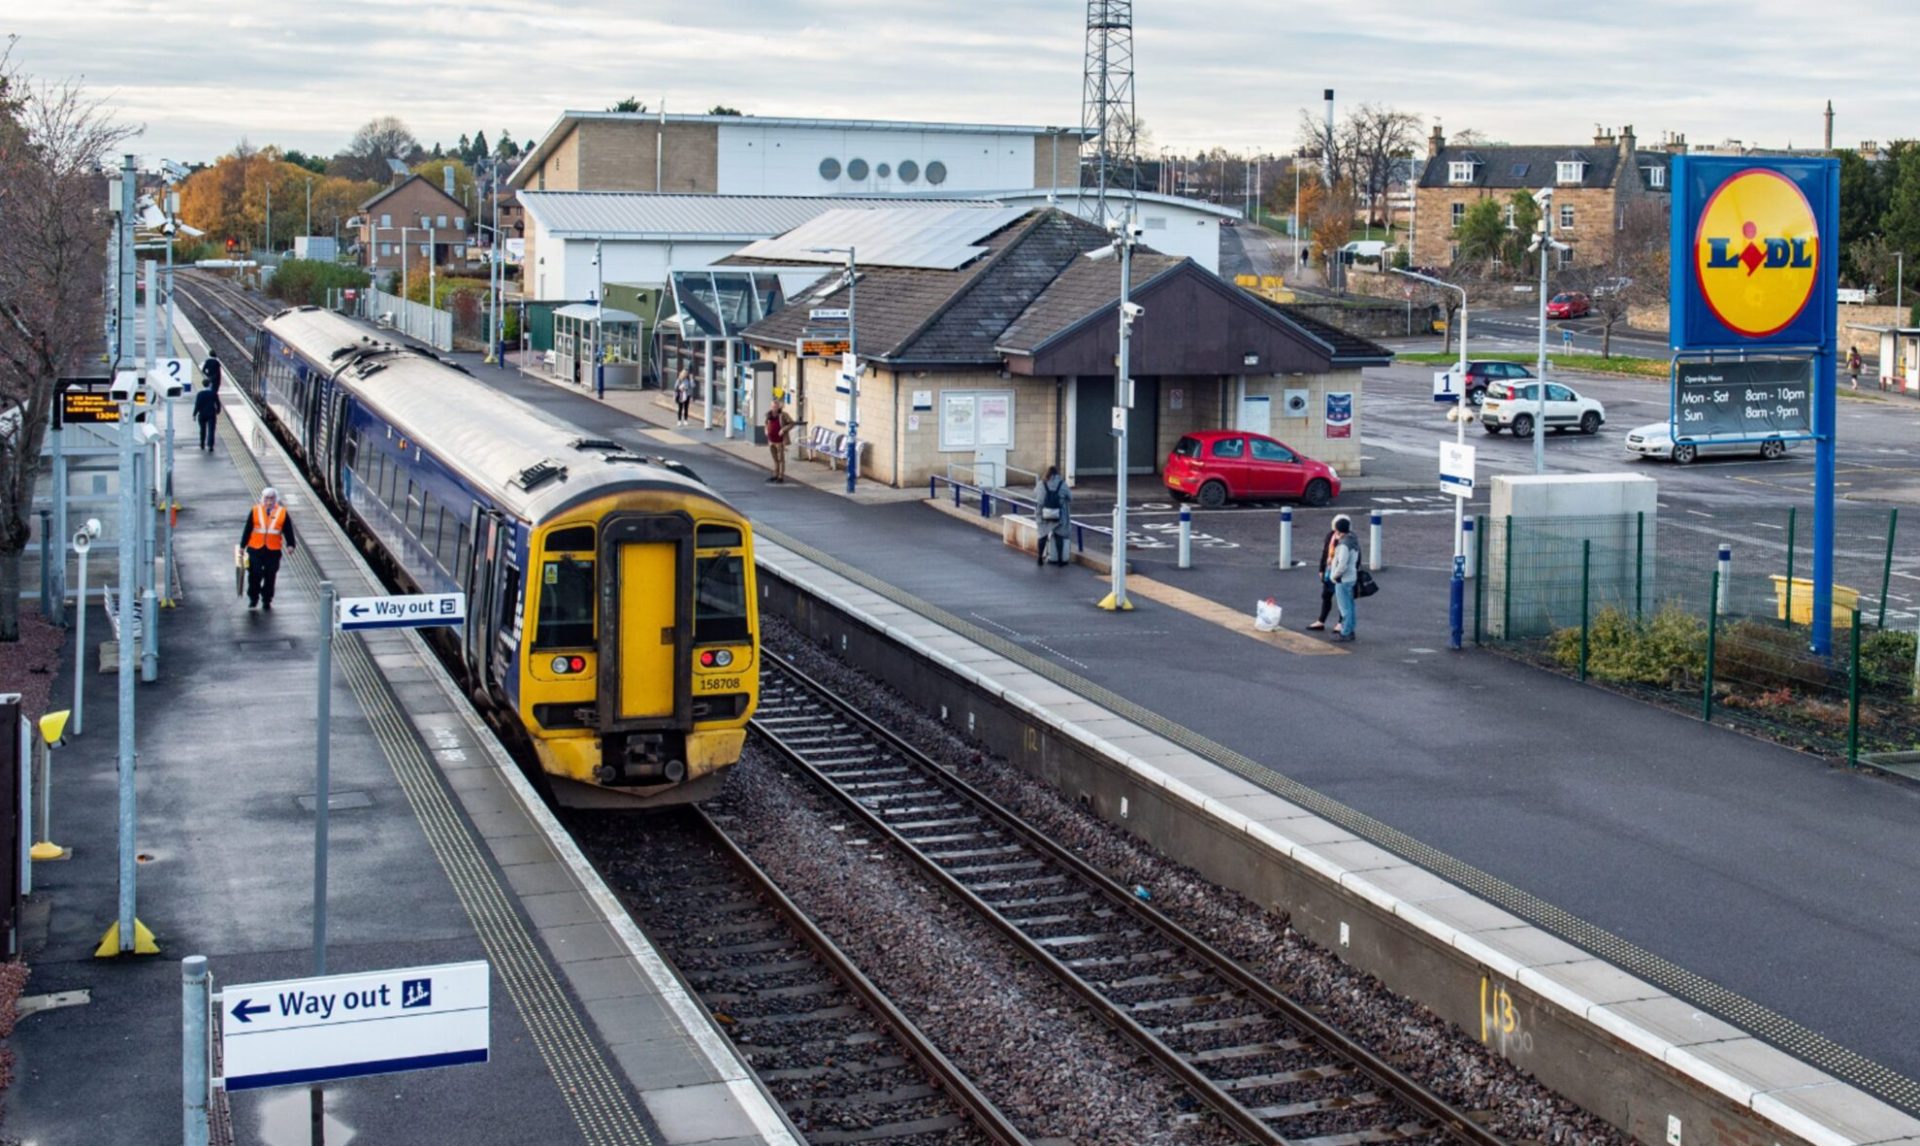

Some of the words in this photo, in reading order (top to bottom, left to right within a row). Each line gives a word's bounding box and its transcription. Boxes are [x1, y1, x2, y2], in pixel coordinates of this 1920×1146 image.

[167, 361, 181, 381] 2
[1442, 374, 1451, 392] 1
[1681, 391, 1704, 404] Mon
[1713, 390, 1730, 402] Sat
[1745, 389, 1768, 401] 8am
[1777, 387, 1805, 402] 10pm
[1684, 408, 1703, 421] Sun
[1745, 406, 1768, 419] 8am
[1776, 405, 1799, 420] 9pm
[375, 601, 405, 617] Way
[409, 600, 434, 613] out
[701, 677, 741, 690] 158708
[278, 990, 336, 1019] Way
[343, 984, 390, 1010] out
